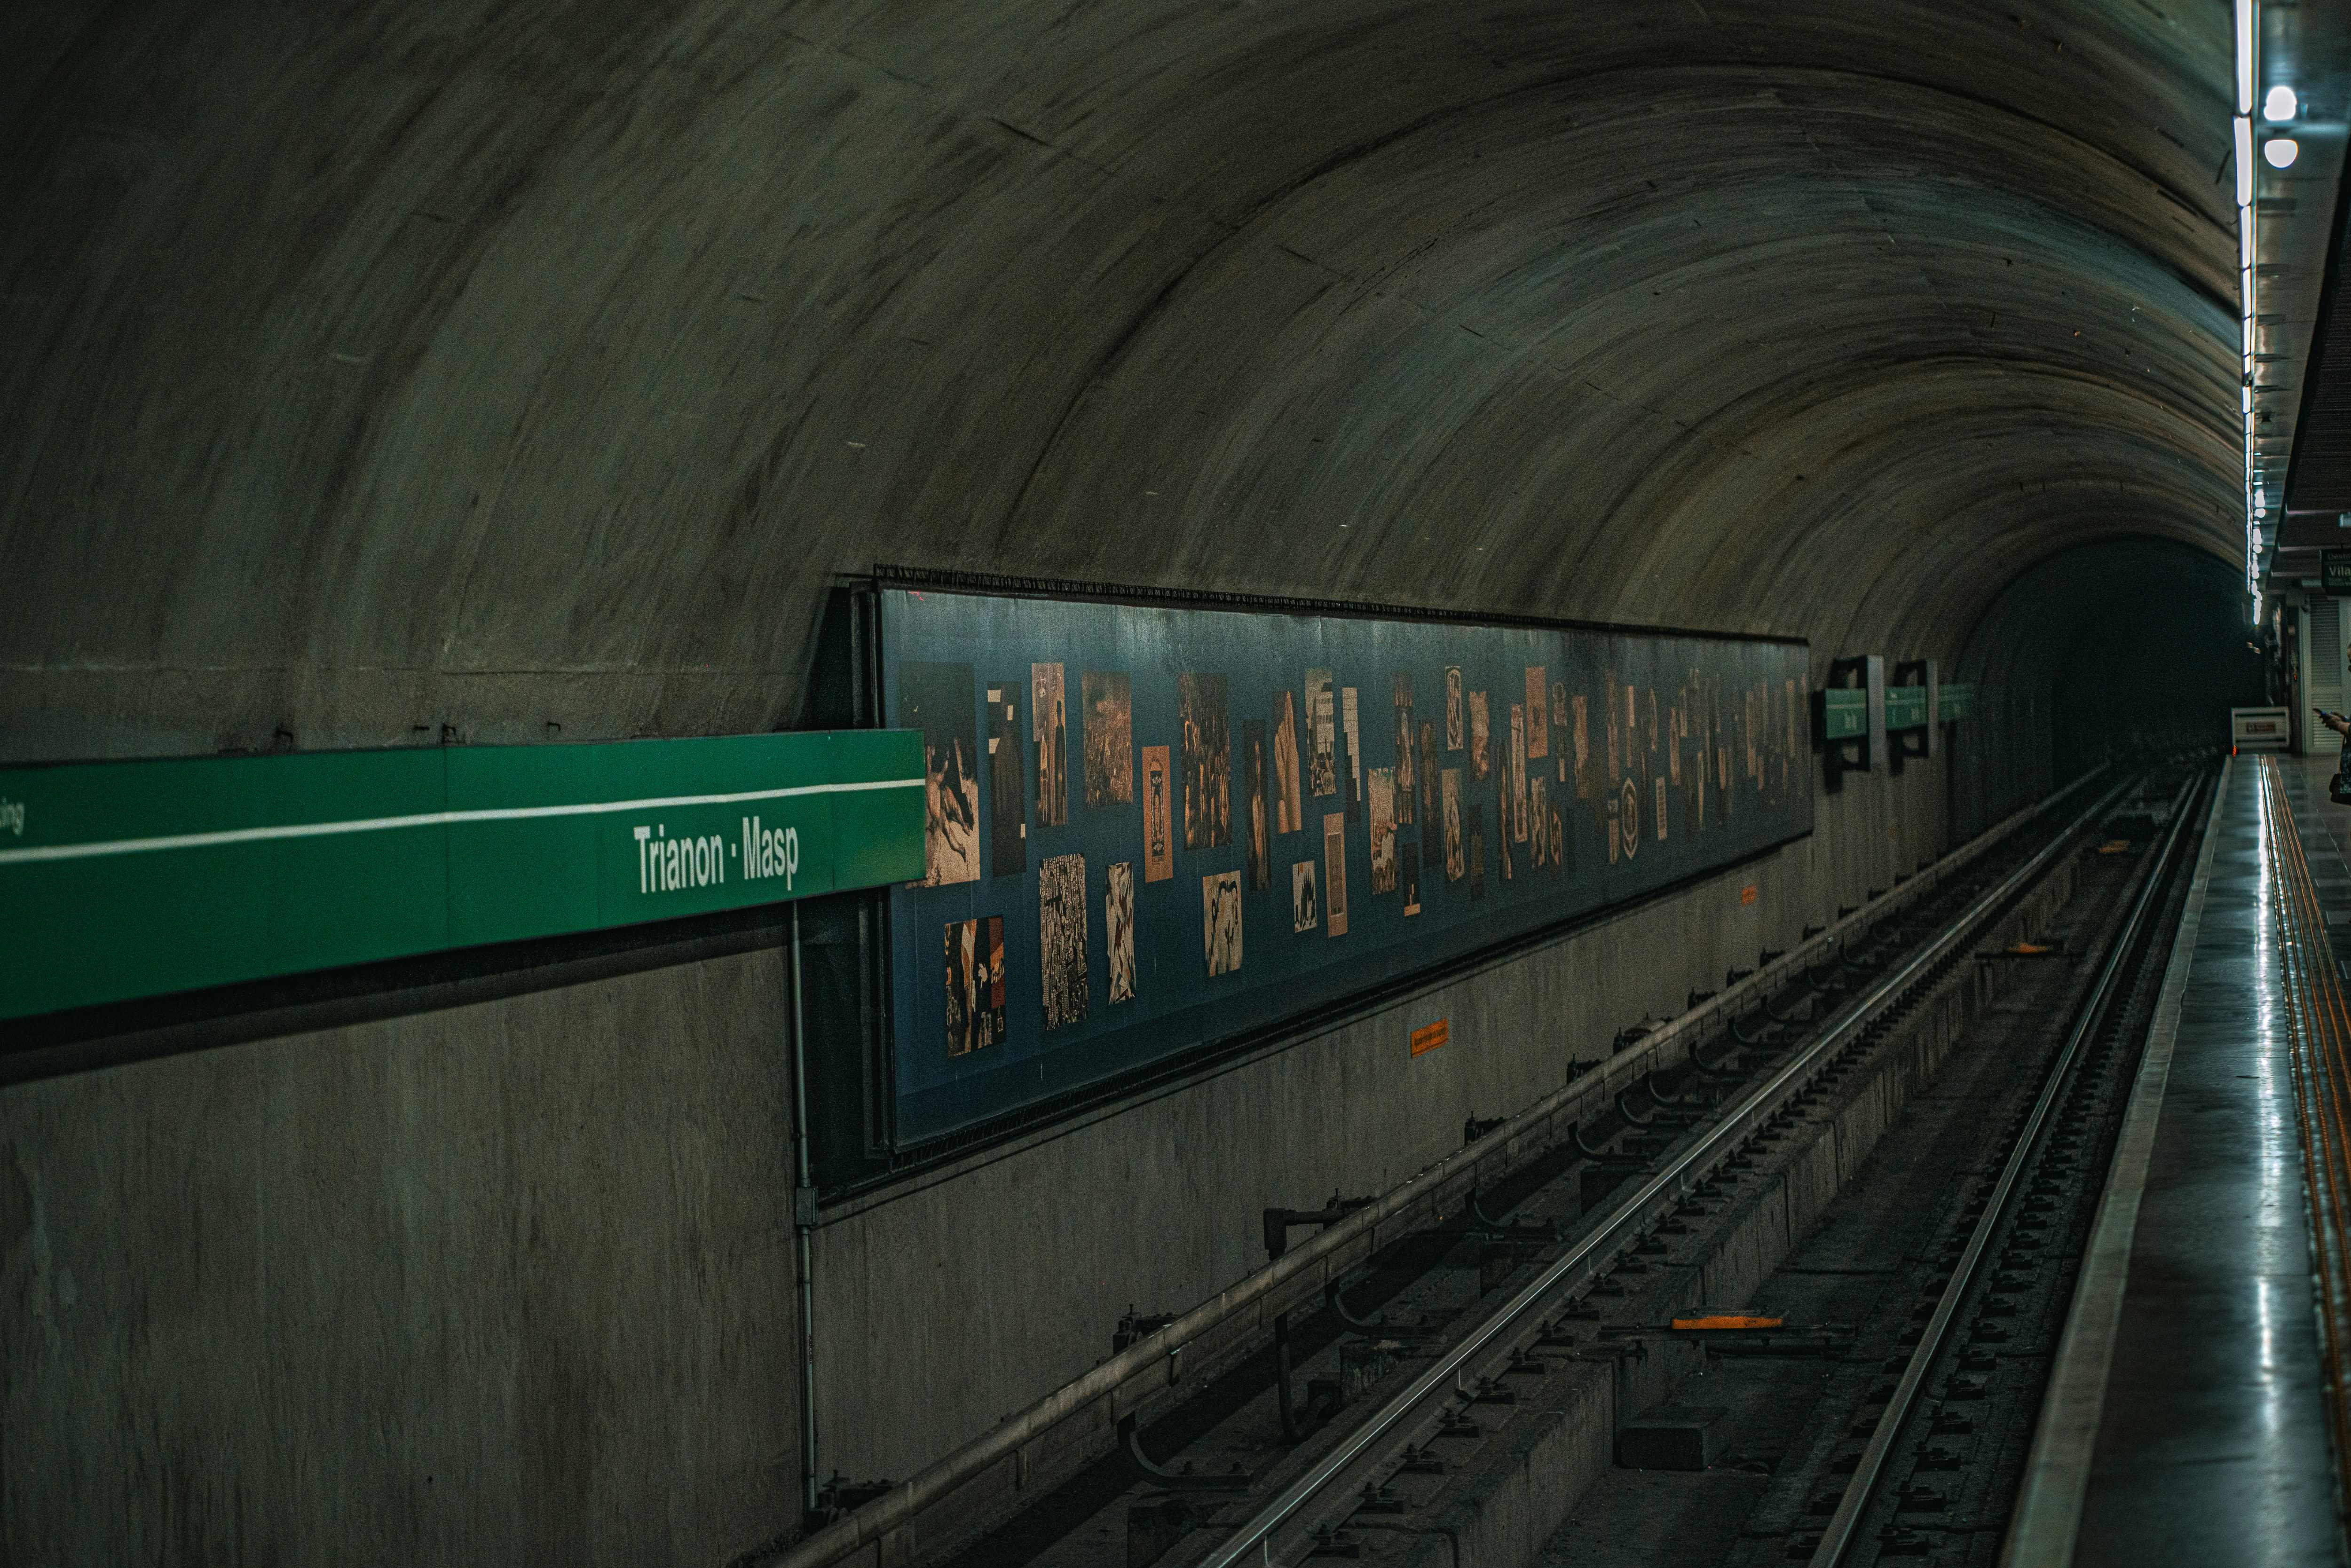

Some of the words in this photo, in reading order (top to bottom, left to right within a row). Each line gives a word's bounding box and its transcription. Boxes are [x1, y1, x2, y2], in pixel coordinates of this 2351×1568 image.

[2329, 565, 2351, 576] Vila
[0, 796, 25, 836] ing
[633, 823, 725, 894] Trianon
[742, 816, 799, 891] Masp
